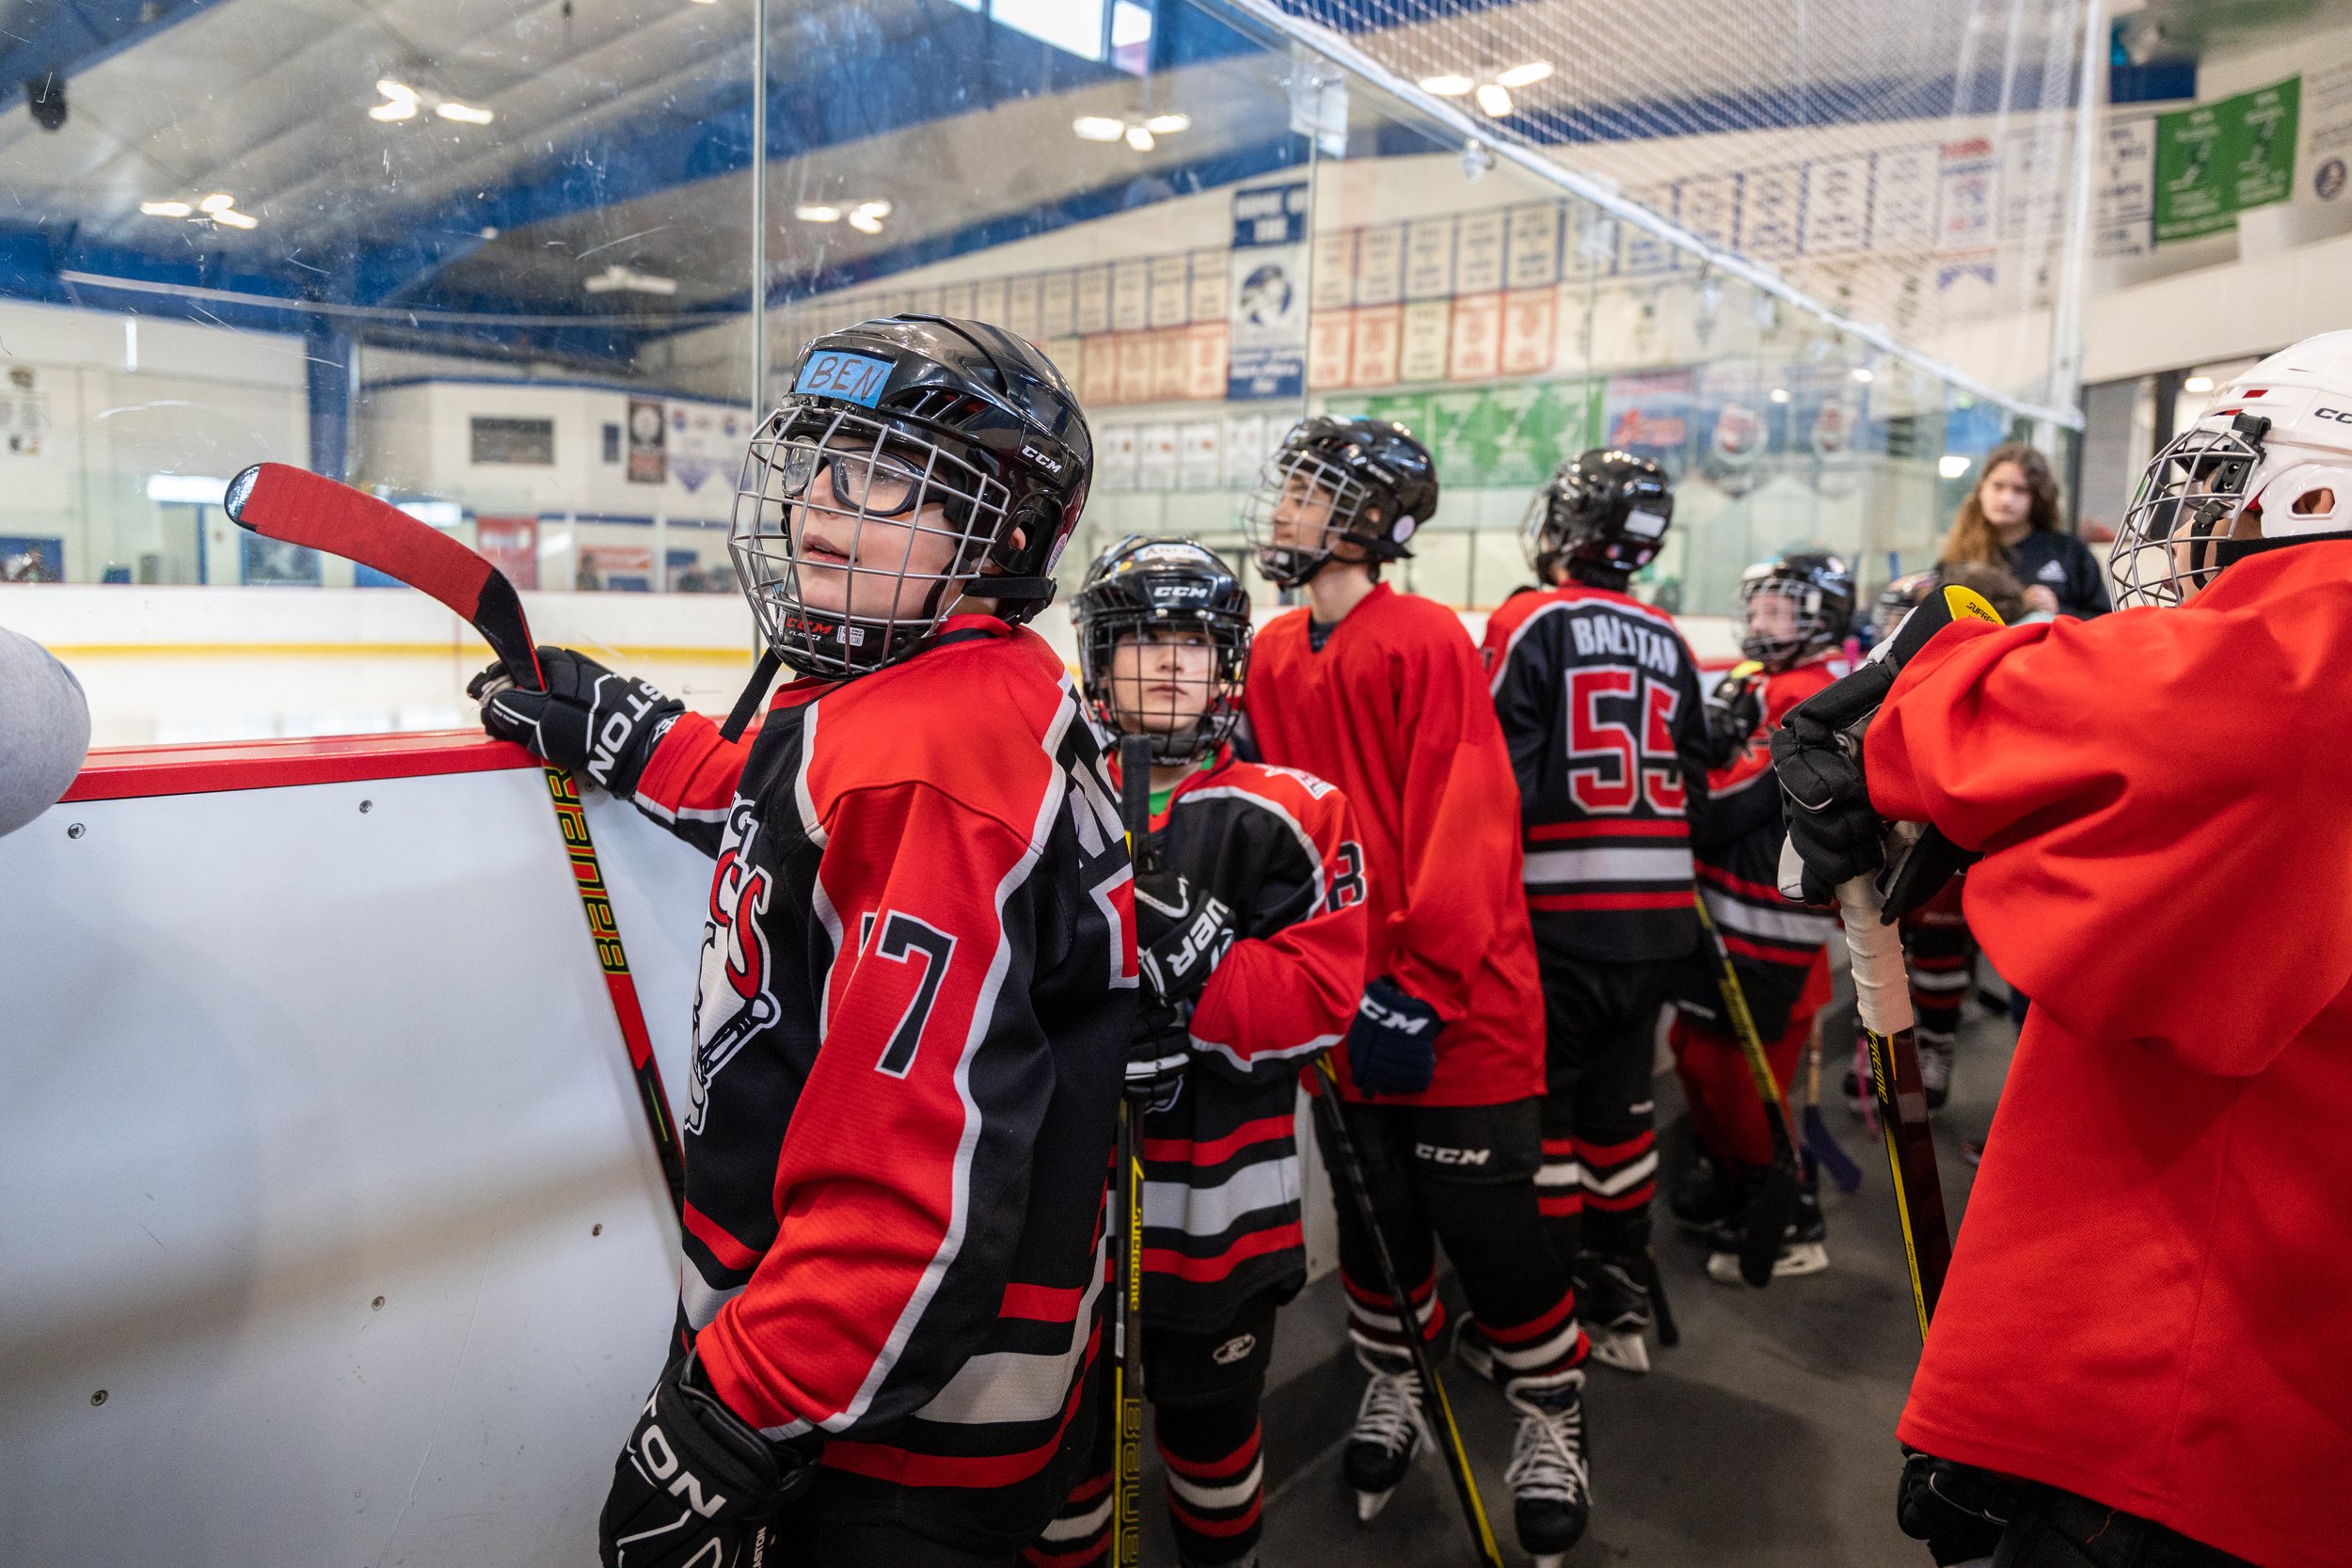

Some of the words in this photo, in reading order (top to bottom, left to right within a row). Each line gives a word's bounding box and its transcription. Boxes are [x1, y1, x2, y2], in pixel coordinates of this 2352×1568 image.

[807, 356, 884, 402] BEN
[1022, 444, 1062, 473] CCM
[1153, 586, 1208, 598] CCM
[1565, 663, 1690, 816] 55
[858, 908, 959, 1081] 7
[1414, 1142, 1491, 1166] CCM
[1120, 1398, 1142, 1568] BAUE
[753, 1526, 767, 1568] ASTON
